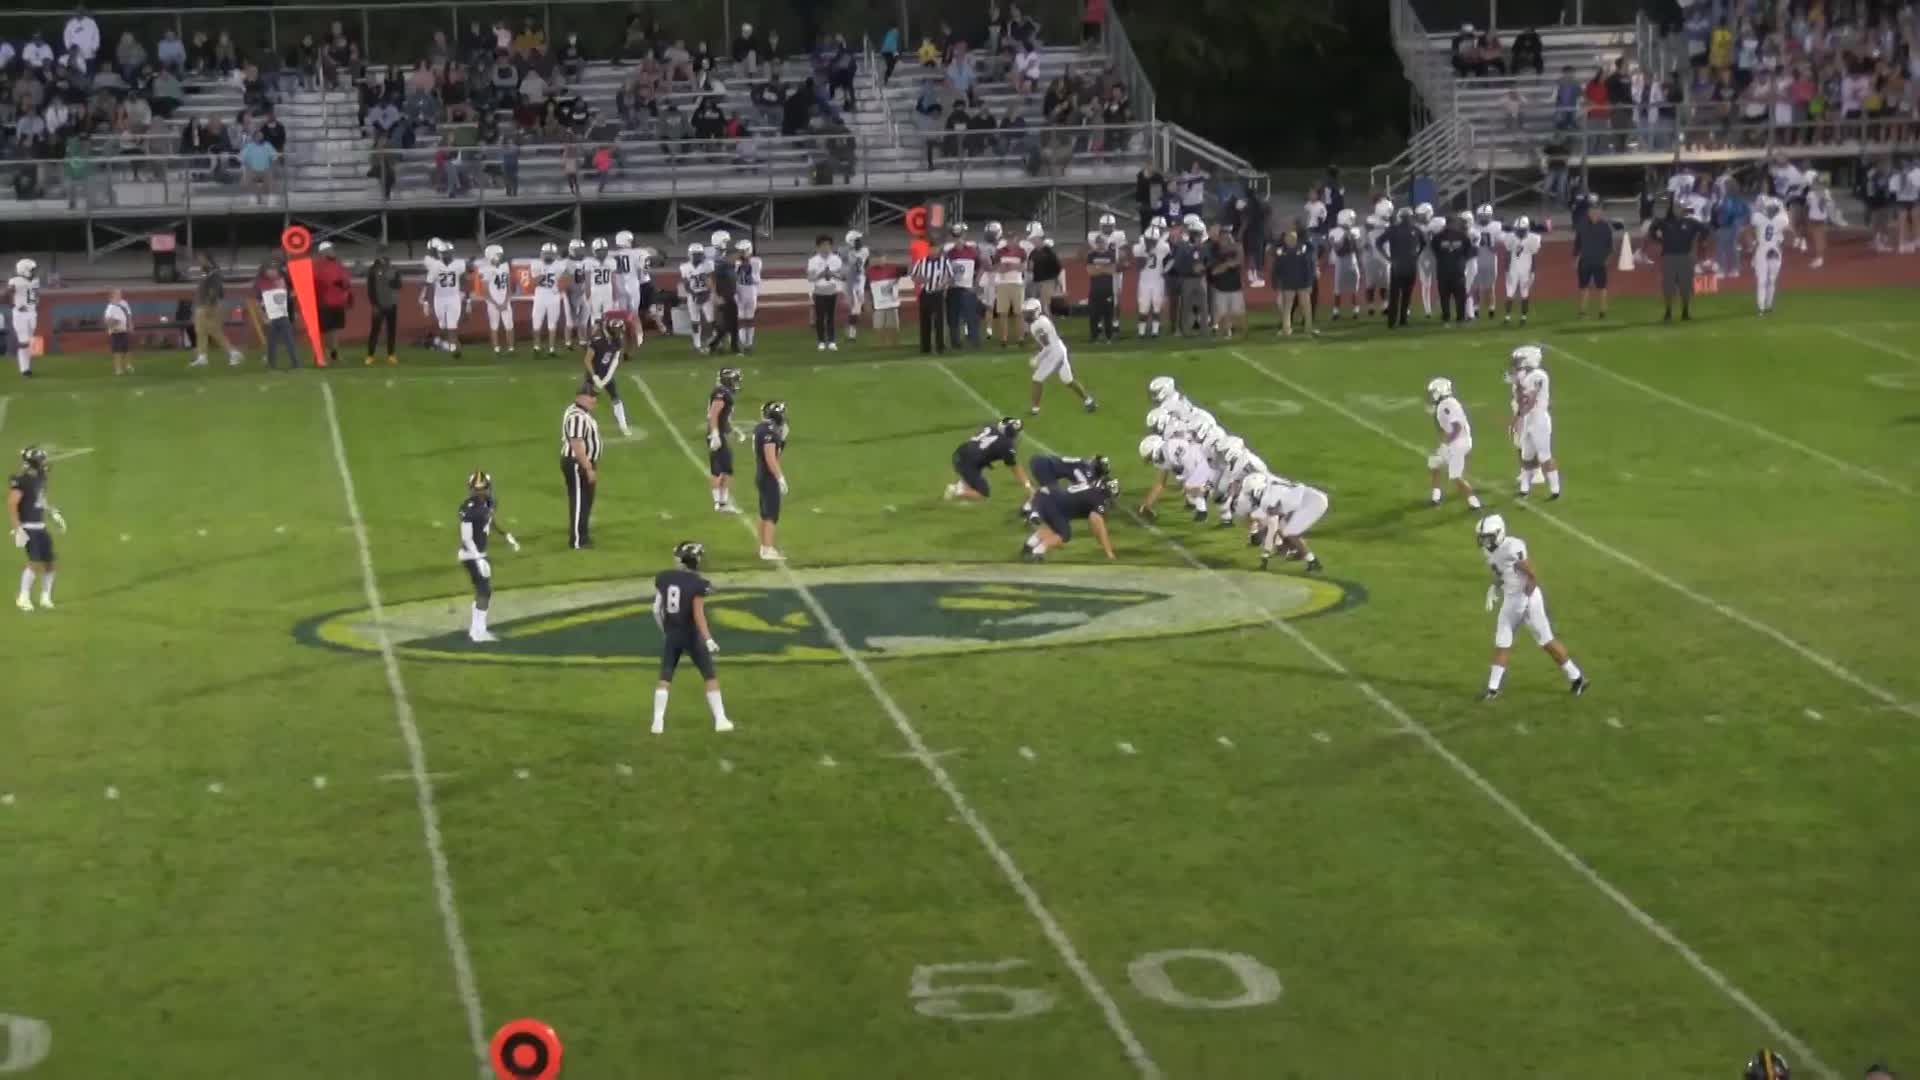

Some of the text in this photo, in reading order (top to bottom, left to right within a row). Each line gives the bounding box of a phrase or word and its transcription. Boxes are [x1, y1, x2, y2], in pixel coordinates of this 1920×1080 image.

[439, 271, 456, 288] 23
[594, 268, 611, 286] 20
[666, 584, 681, 614] 8
[909, 948, 1283, 1021] 50
